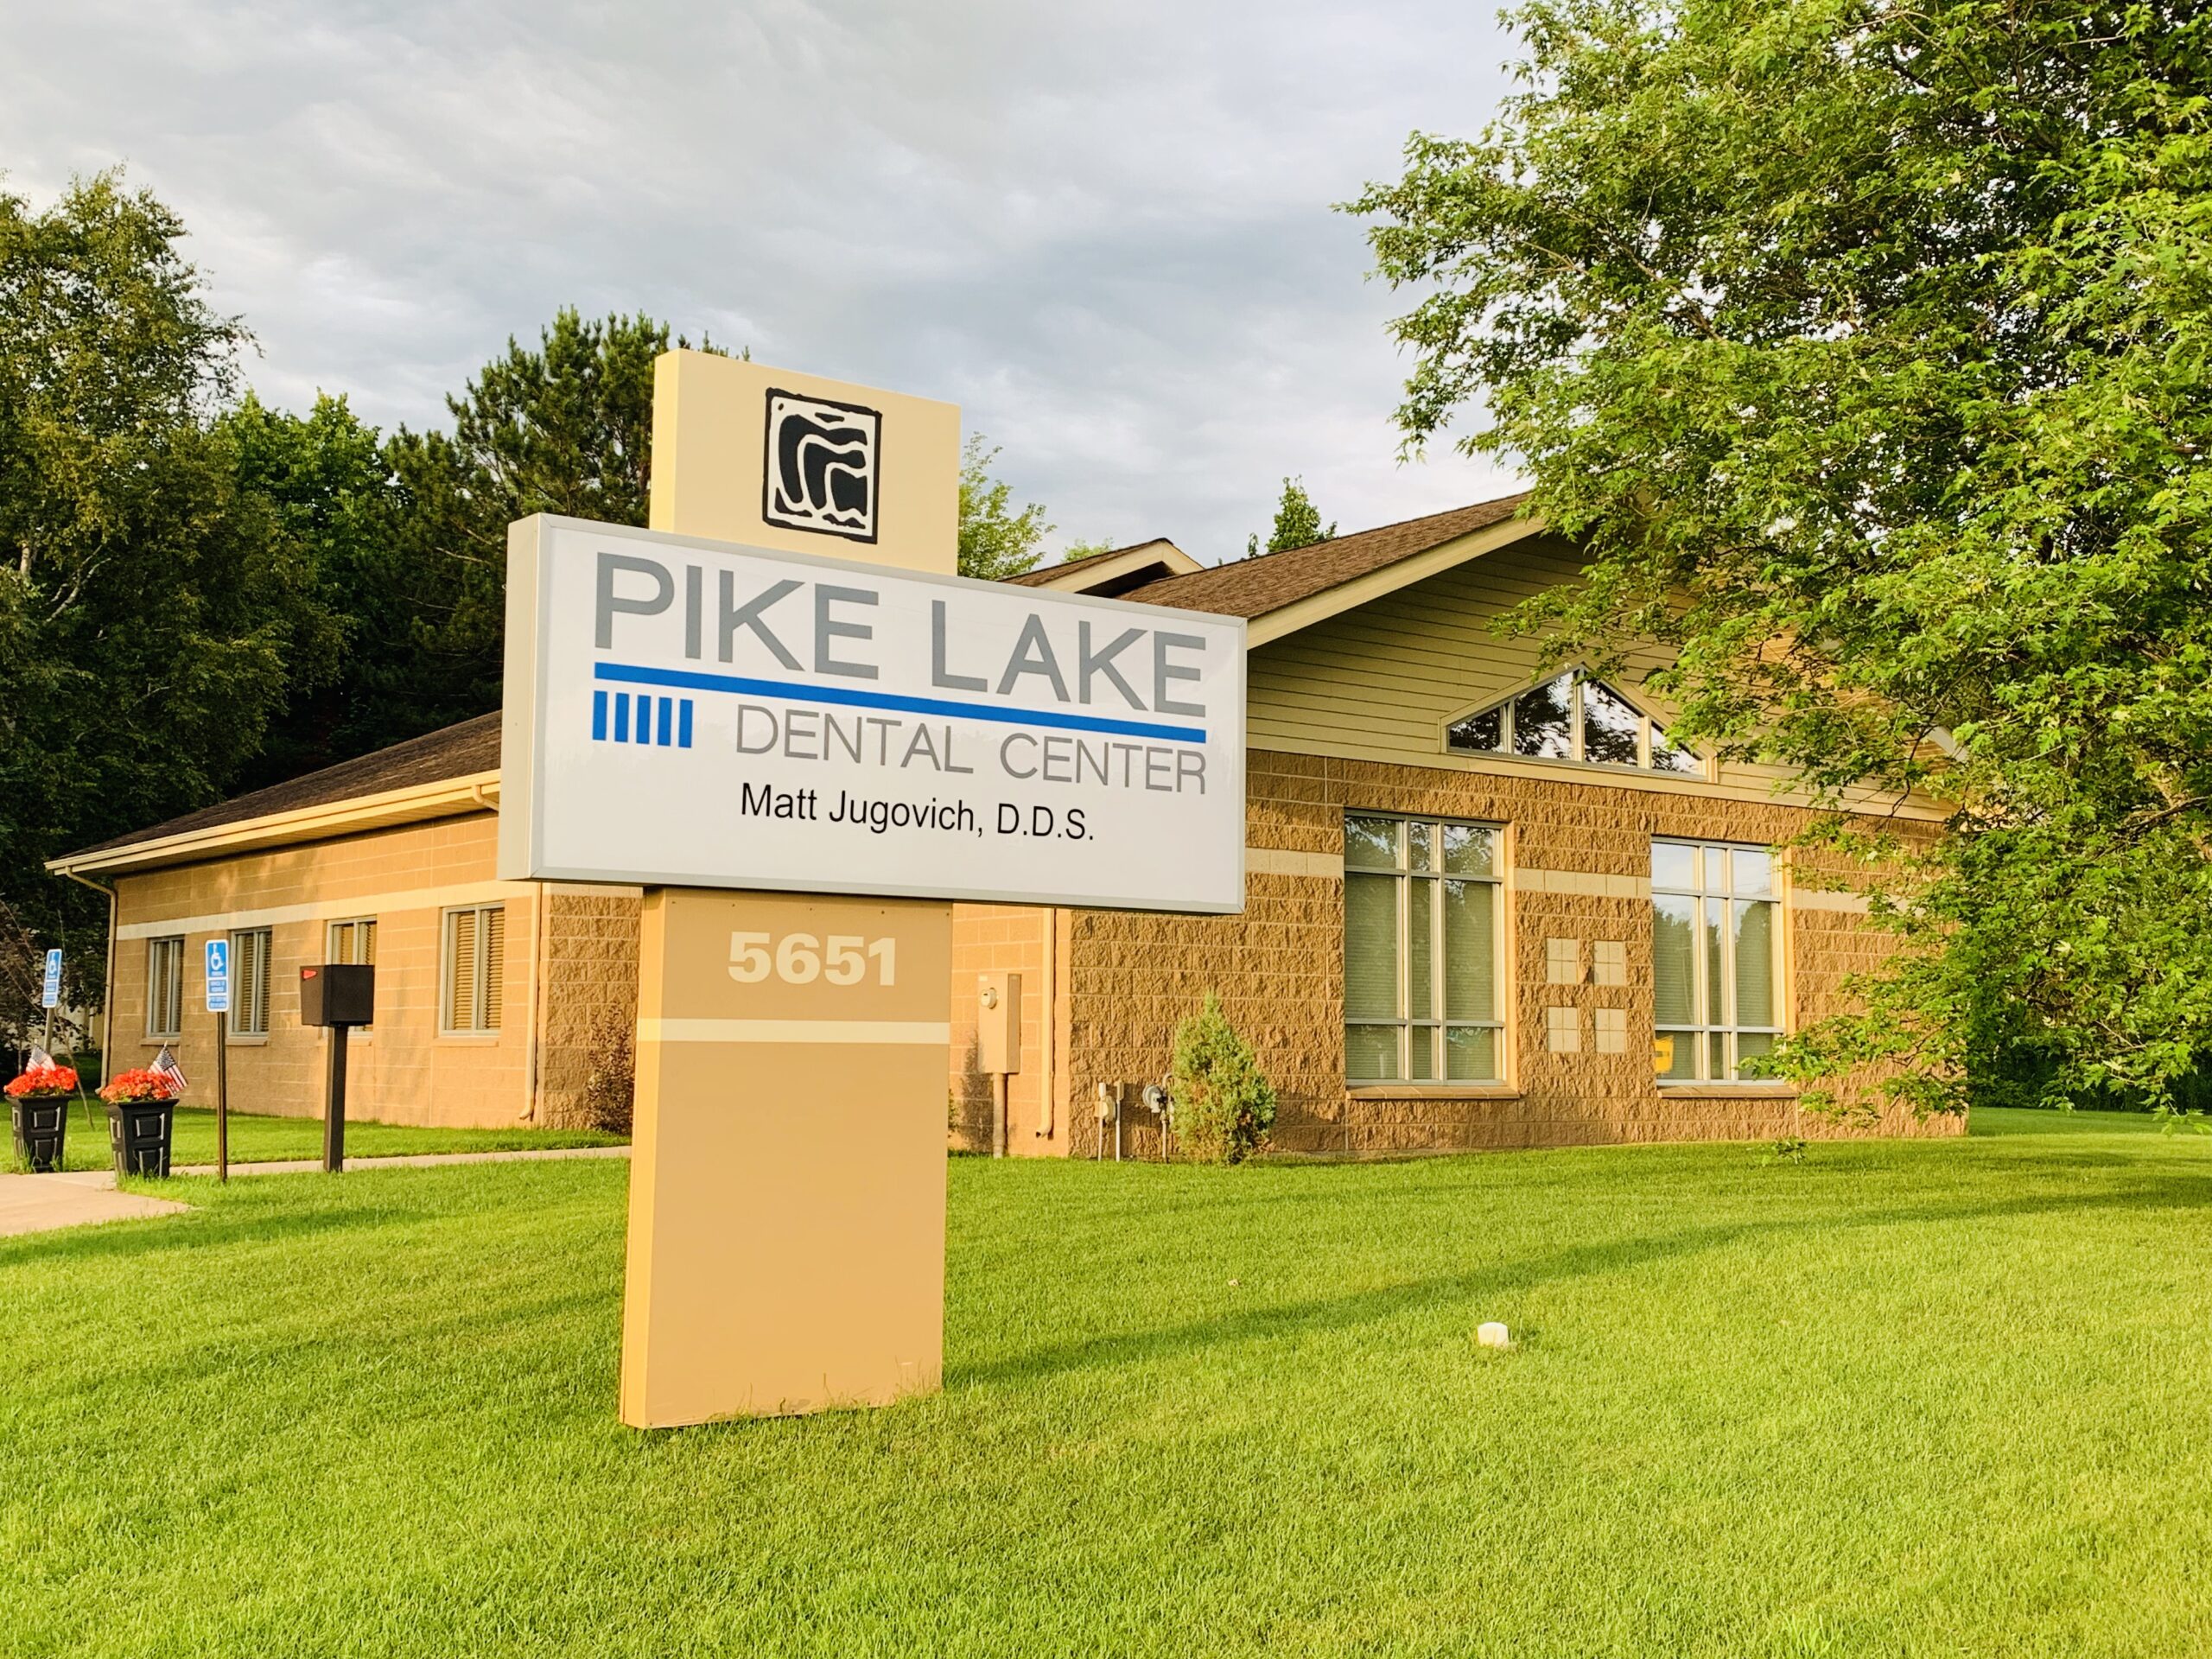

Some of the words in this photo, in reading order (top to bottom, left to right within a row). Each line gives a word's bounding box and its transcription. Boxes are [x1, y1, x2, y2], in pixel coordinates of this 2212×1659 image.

[595, 552, 878, 679] PIKE
[932, 600, 1206, 718] LAKE
[737, 705, 974, 773] DENTAL
[1001, 733, 1206, 795] CENTER
[741, 782, 817, 822] Matt
[830, 789, 983, 837] Jugovich,
[998, 803, 1094, 840] D.D.S.
[728, 931, 895, 986] 5651
